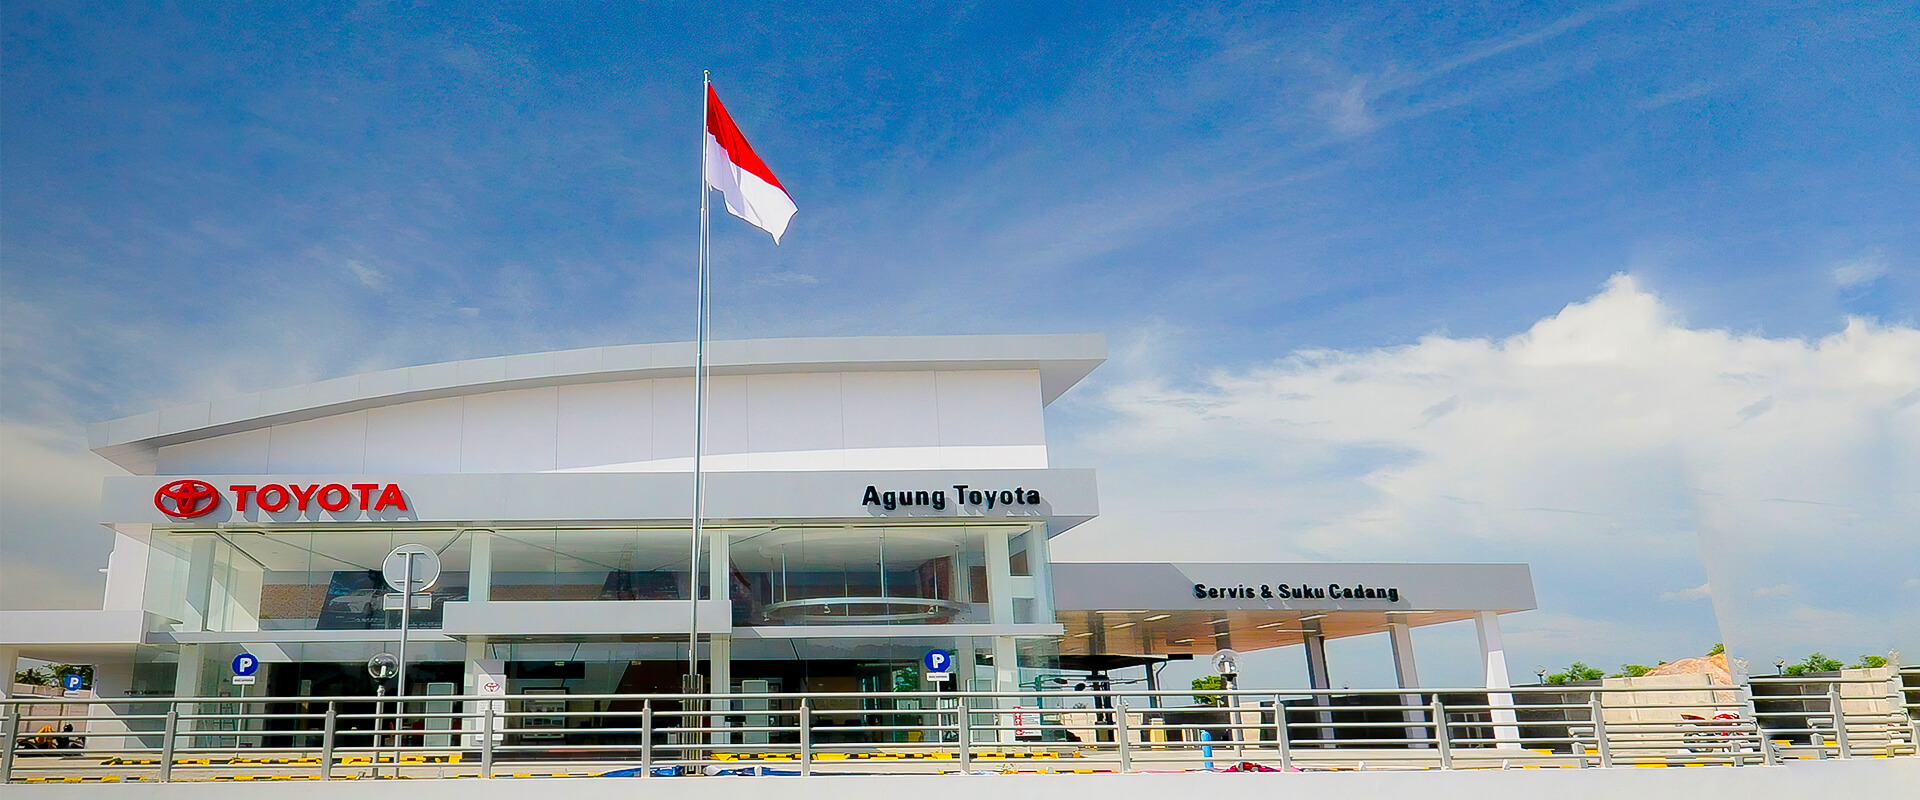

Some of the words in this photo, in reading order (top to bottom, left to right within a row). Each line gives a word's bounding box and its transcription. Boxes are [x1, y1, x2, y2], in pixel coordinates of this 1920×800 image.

[229, 483, 408, 512] TOYOTA
[861, 485, 946, 511] Agung
[952, 484, 1041, 510] Toyota
[1194, 583, 1256, 599] Servis
[1260, 584, 1274, 599] &
[1278, 583, 1325, 599] Suku
[1328, 583, 1399, 602] Cadang
[239, 657, 253, 673] P
[932, 653, 945, 669] P
[69, 676, 80, 688] P
